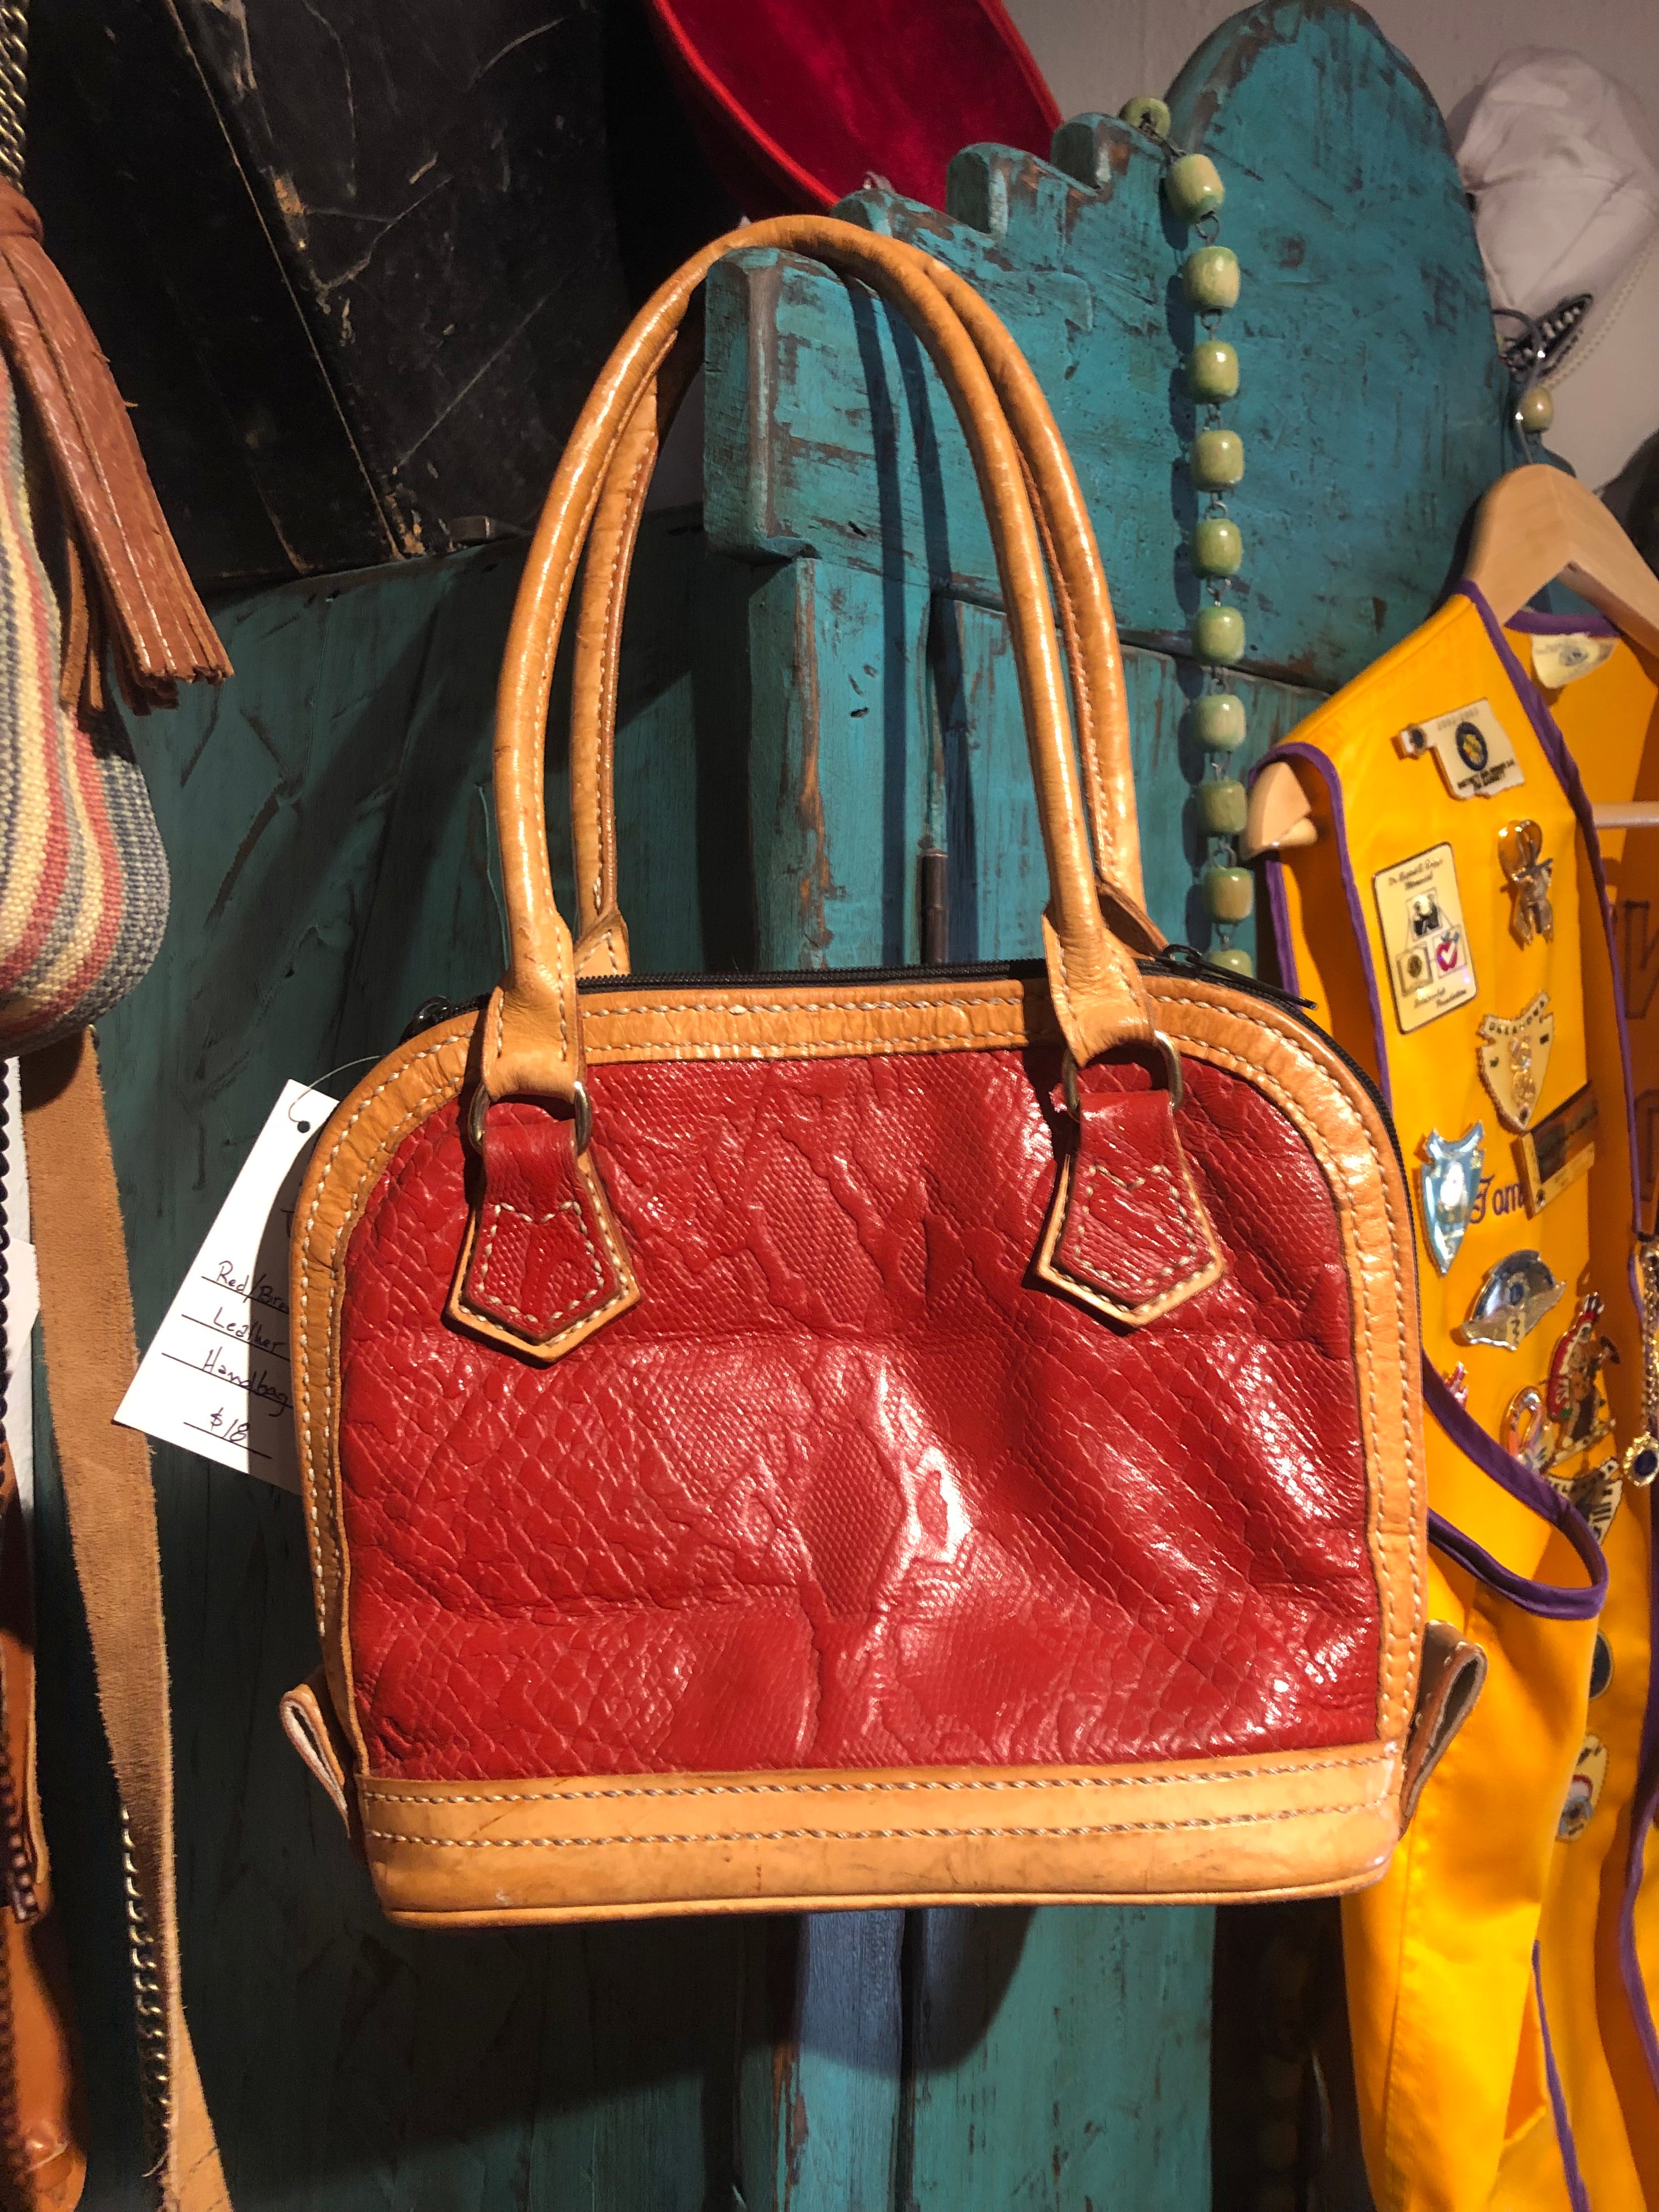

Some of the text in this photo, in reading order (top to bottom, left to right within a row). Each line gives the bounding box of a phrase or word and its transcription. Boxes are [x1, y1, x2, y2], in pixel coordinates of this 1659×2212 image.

[216, 1260, 289, 1312] Red/Bro
[213, 1306, 286, 1353] Leather
[202, 1346, 288, 1418] Handbag
[210, 1407, 251, 1443] $18
